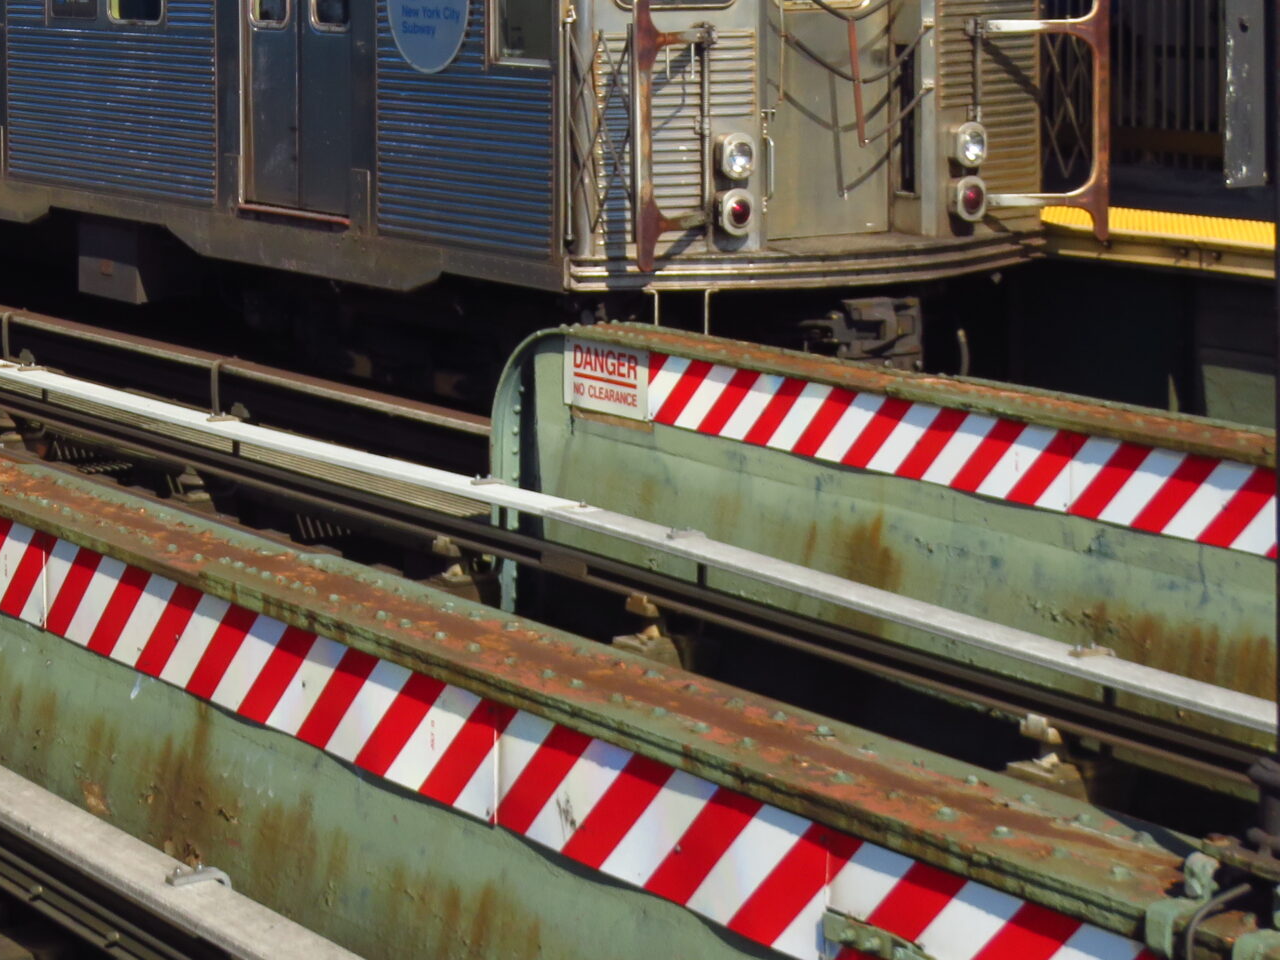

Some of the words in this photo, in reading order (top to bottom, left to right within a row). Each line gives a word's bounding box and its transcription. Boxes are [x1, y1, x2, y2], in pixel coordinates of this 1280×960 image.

[402, 6, 419, 18] New
[422, 6, 440, 19] York
[443, 7, 460, 24] City
[402, 21, 436, 38] Subway
[573, 344, 638, 380] DANGER
[573, 382, 585, 396] NO
[588, 385, 638, 408] CLEARANCE
